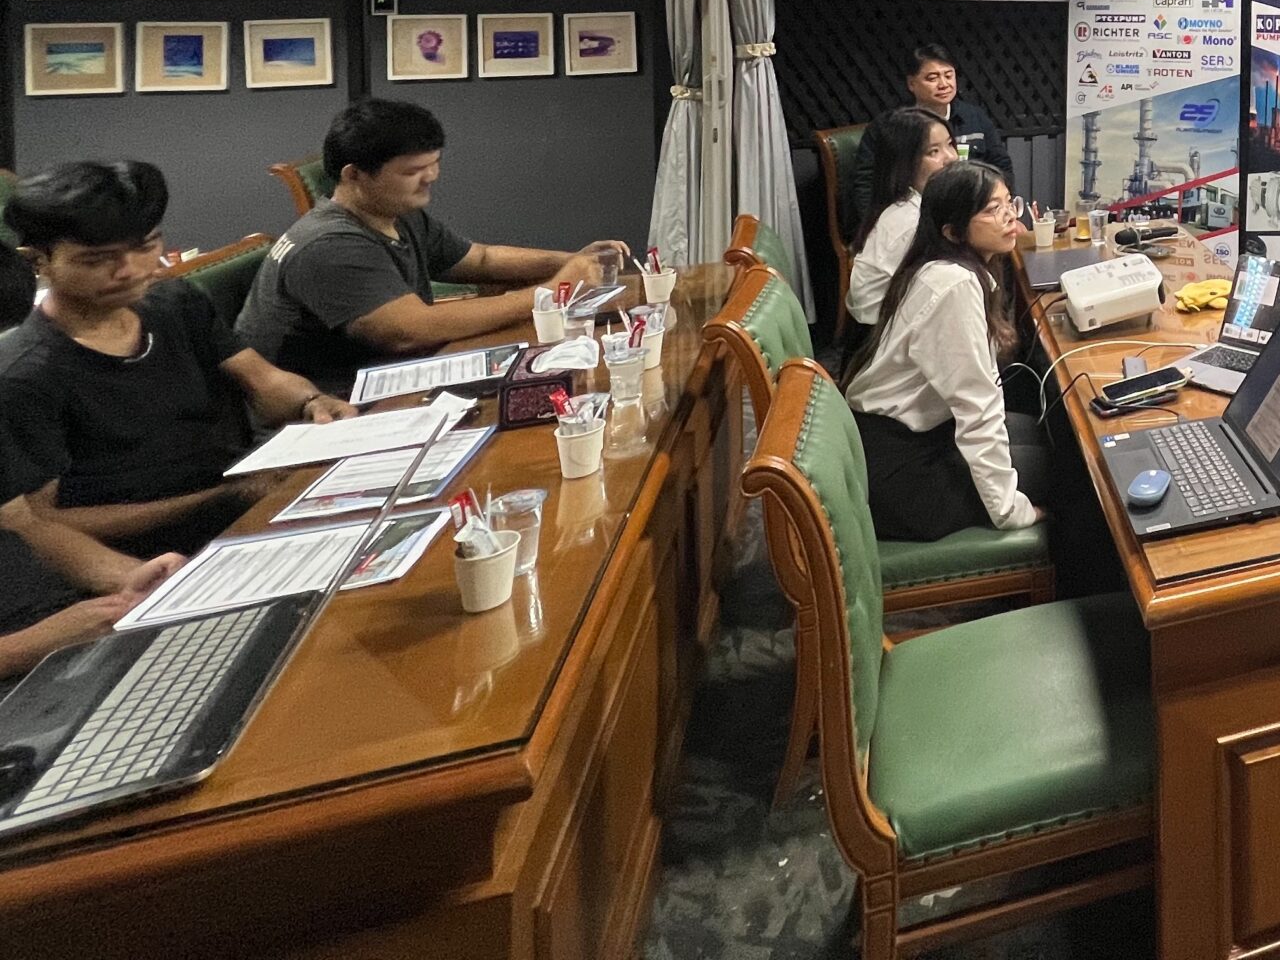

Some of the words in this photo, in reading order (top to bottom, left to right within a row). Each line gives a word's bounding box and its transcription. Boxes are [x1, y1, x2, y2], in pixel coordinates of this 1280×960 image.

[1189, 20, 1222, 28] MOYNO
[1093, 28, 1139, 37] RICHTER
[1203, 36, 1234, 45] Mono
[1155, 49, 1189, 58] VANTON
